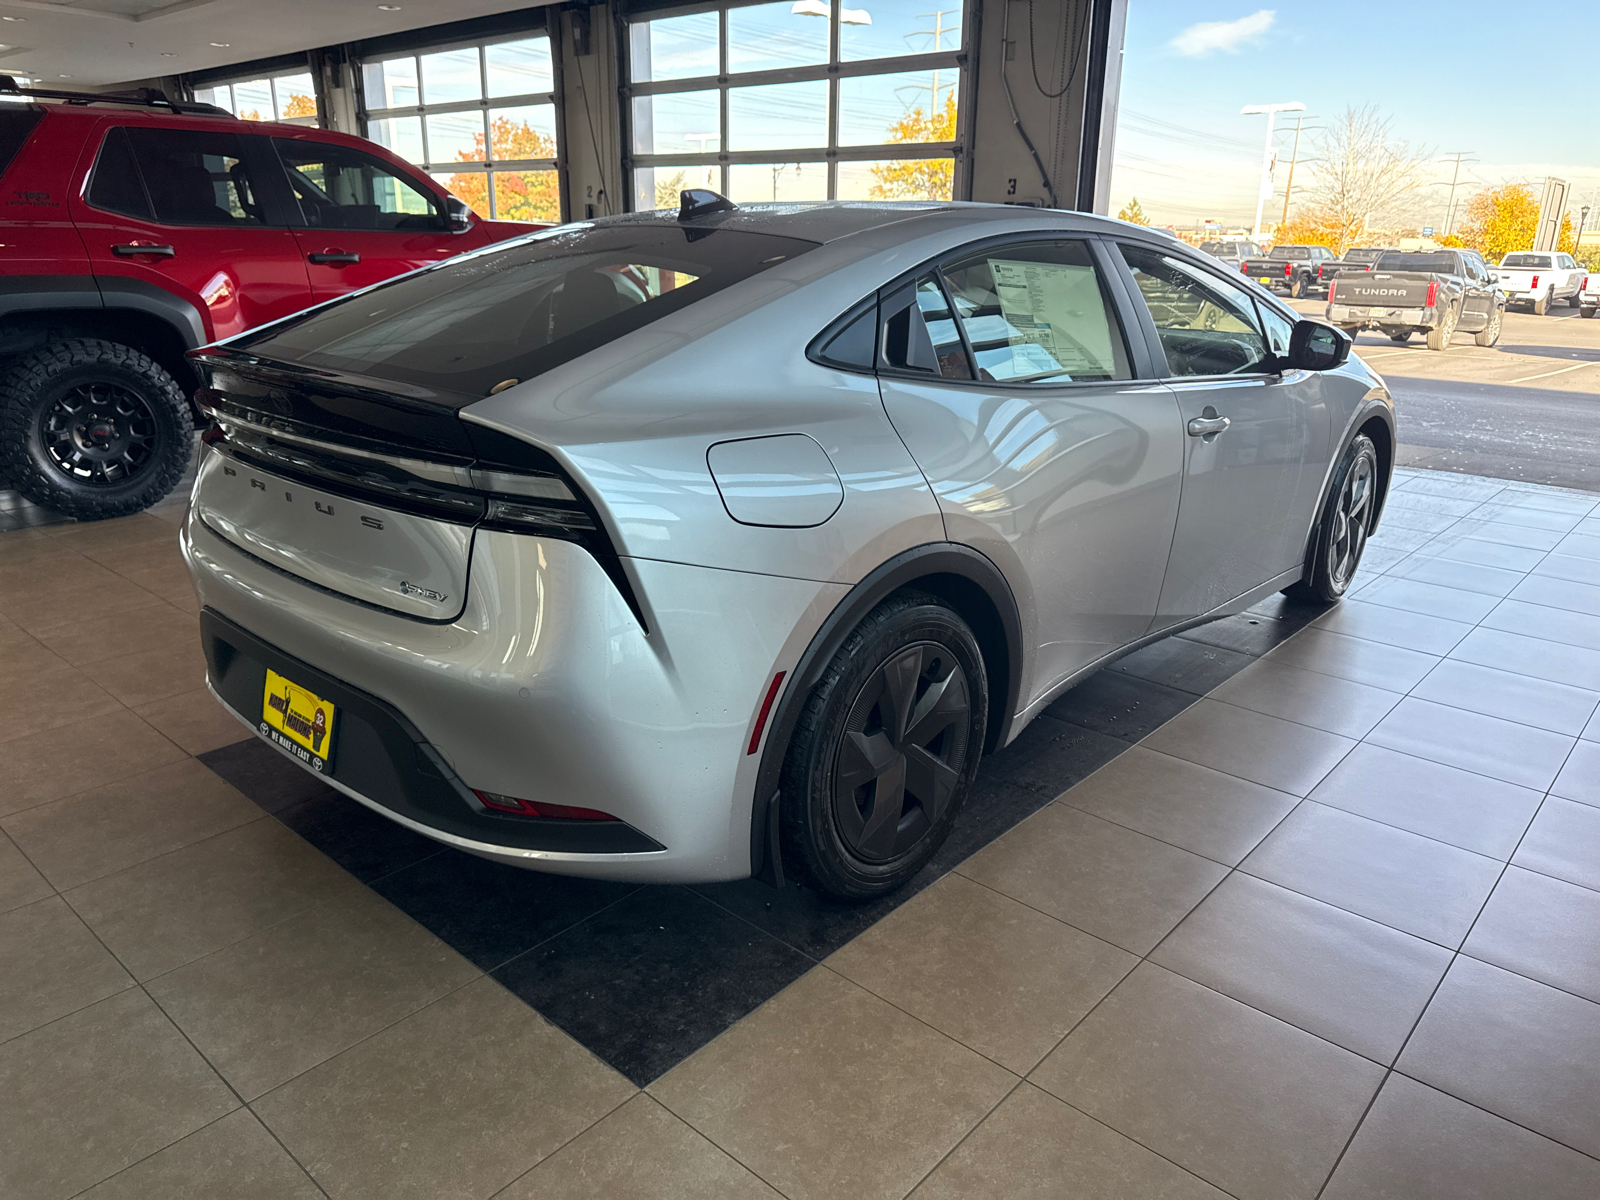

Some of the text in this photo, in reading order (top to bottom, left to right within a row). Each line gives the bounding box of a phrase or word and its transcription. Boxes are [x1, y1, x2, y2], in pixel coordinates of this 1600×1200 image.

[586, 185, 593, 198] 2
[1007, 178, 1017, 195] 3
[1353, 287, 1407, 297] TUNDRA
[223, 465, 384, 530] PRIUS
[408, 584, 449, 603] PHEV
[268, 692, 287, 715] KARL
[286, 712, 312, 740] MALONE
[315, 712, 324, 727] 32
[271, 730, 310, 763] WE MAKE IT EASY
